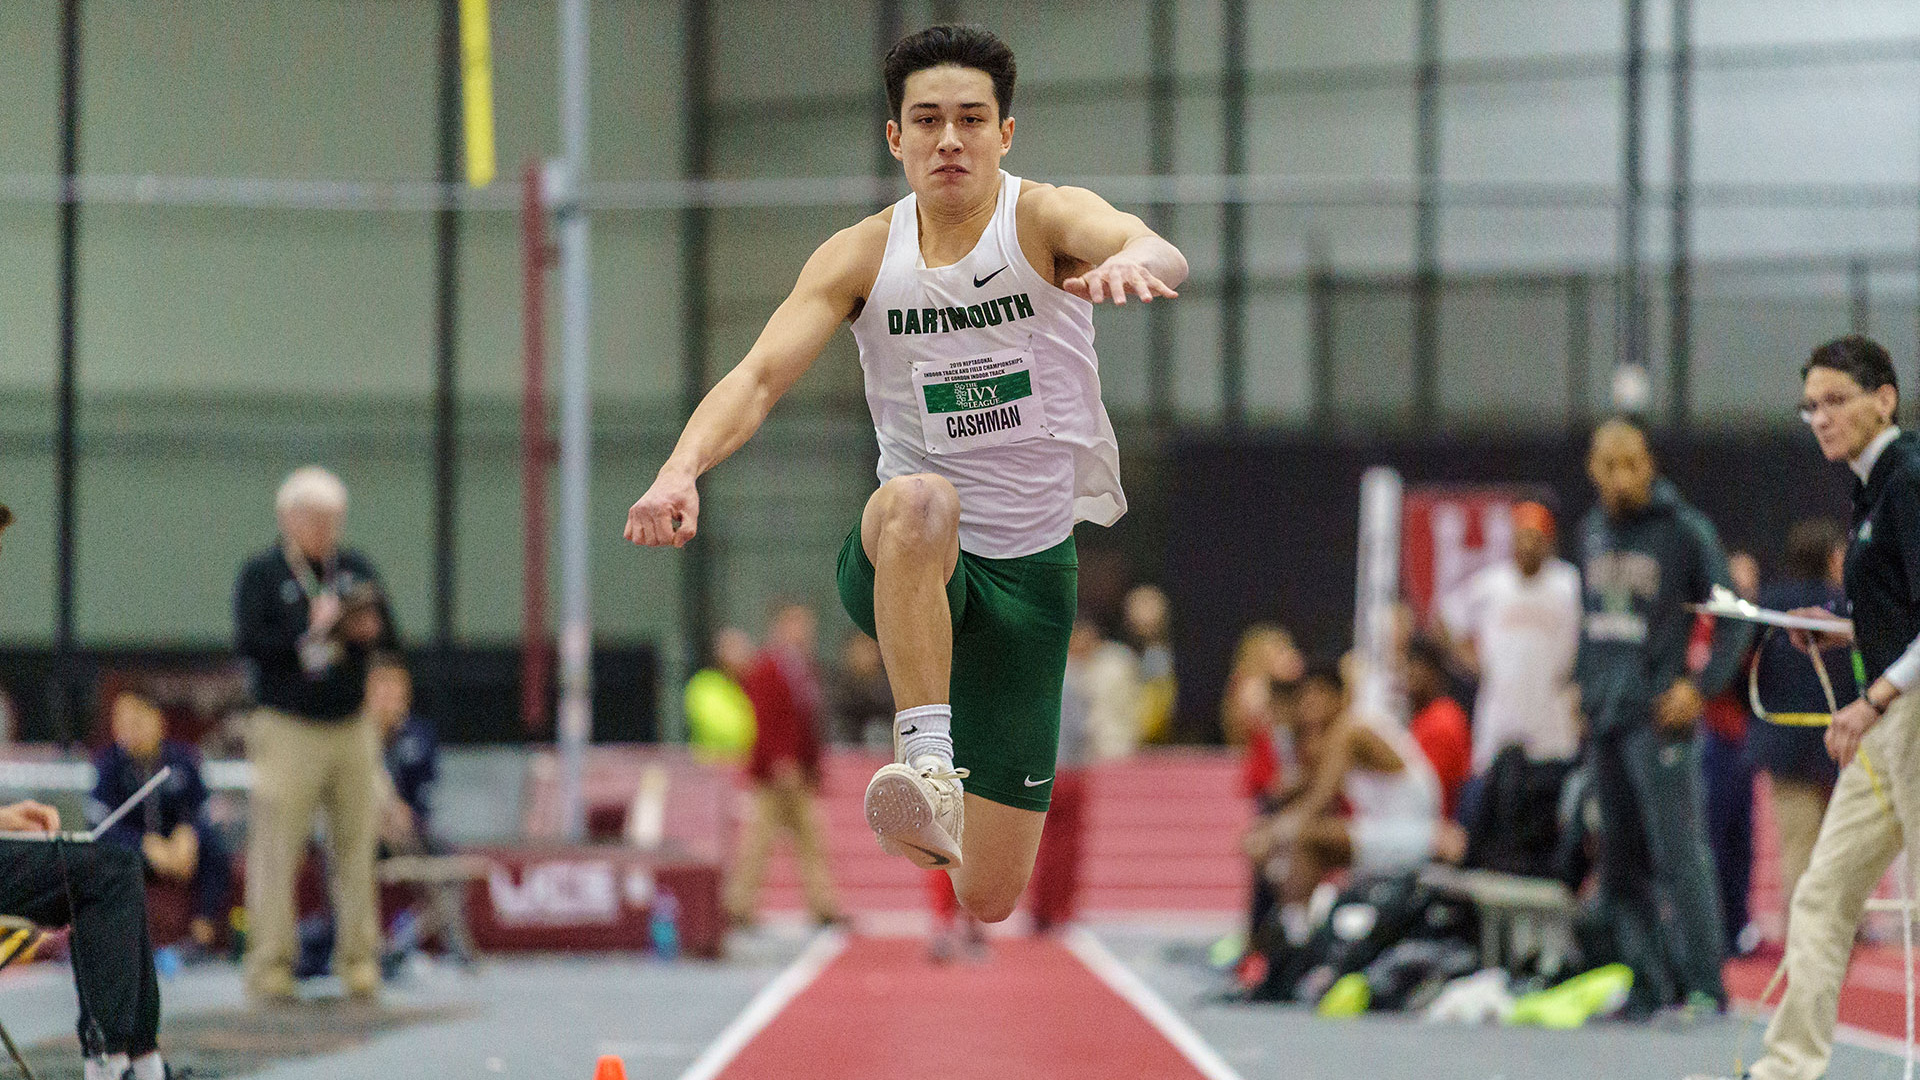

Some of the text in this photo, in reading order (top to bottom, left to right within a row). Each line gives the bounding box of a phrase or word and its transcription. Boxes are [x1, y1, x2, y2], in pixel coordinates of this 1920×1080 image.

[888, 293, 1035, 335] DARTMOUTH
[963, 357, 993, 367] HEPTAGONAL
[983, 357, 1023, 371] CHAMPIONSHIPS
[989, 369, 1006, 377] TRACK
[966, 385, 998, 401] IVY
[968, 398, 1000, 409] LEAGUE
[946, 405, 1021, 438] CASHMAN
